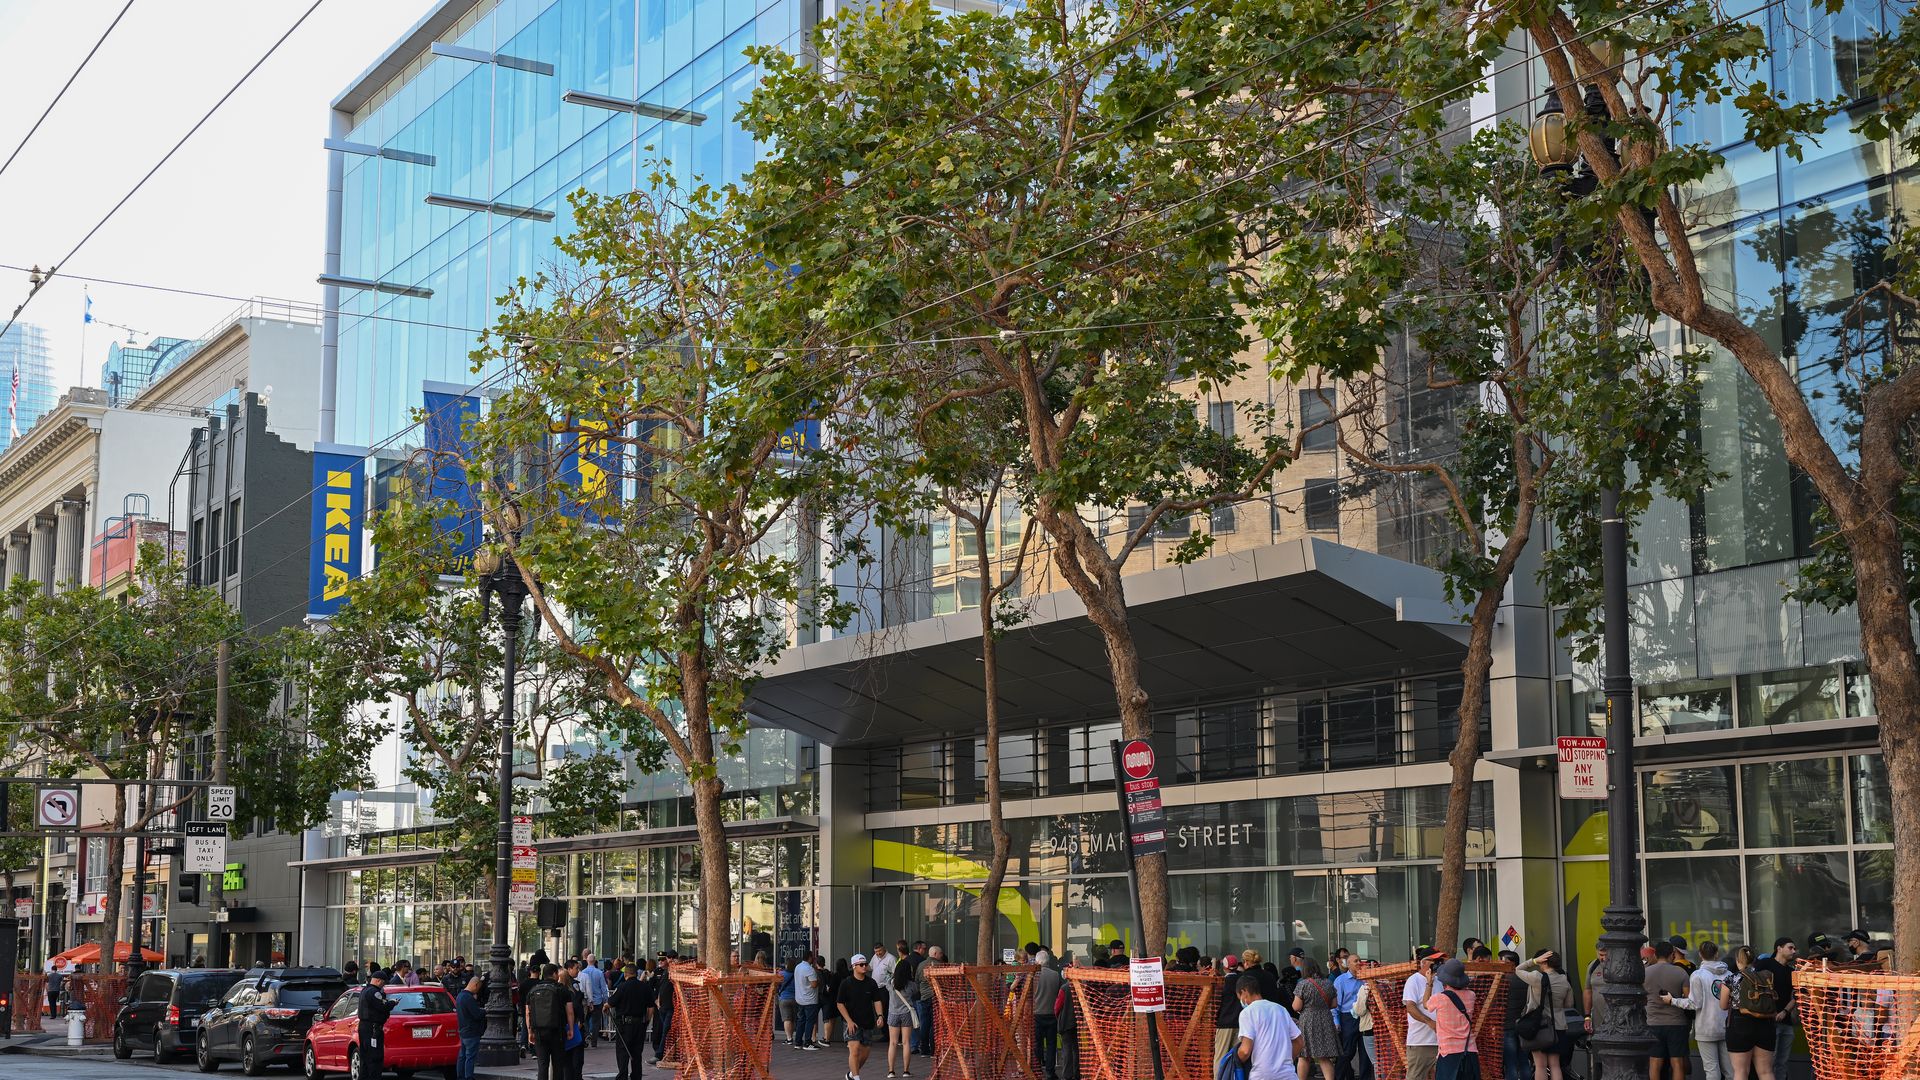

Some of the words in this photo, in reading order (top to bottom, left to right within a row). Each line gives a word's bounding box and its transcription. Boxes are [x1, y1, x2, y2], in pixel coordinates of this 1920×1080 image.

[323, 470, 351, 601] IKEA
[1562, 739, 1602, 748] TOW-AWAY
[1559, 748, 1572, 762] NO
[1574, 749, 1605, 761] STOPPING
[1574, 763, 1593, 774] ANY
[1129, 781, 1140, 791] bus
[1141, 780, 1154, 789] stop
[1573, 775, 1594, 786] TIME
[1127, 793, 1133, 803] 5
[210, 804, 232, 817] 20
[1130, 814, 1135, 824] 7
[1050, 834, 1078, 856] 945
[1178, 823, 1253, 848] STREET
